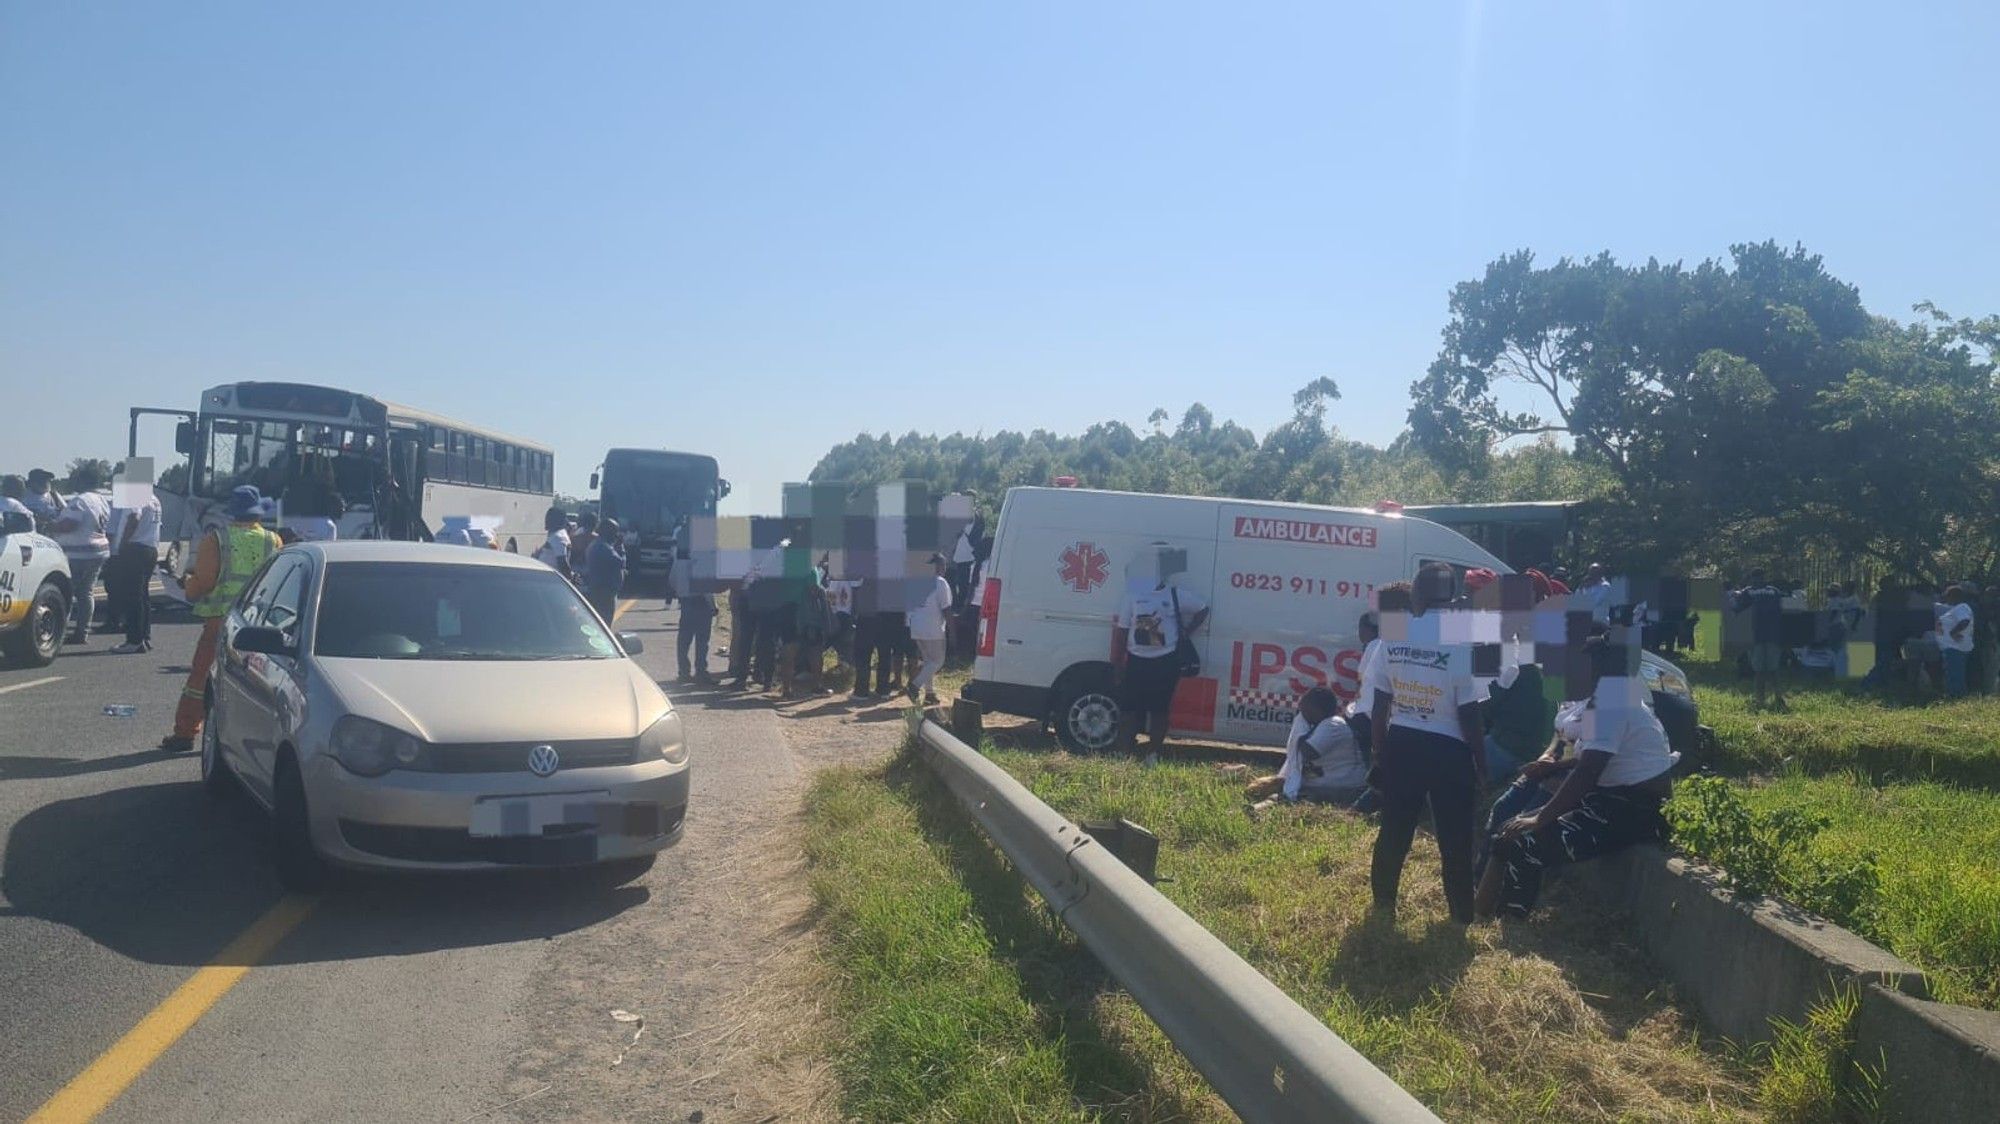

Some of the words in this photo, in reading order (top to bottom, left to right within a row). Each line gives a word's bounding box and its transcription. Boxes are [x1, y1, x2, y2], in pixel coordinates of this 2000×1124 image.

[1240, 518, 1372, 546] AMBULANCE
[1231, 572, 1282, 592] 0823
[1290, 576, 1326, 595] 911
[1231, 641, 1362, 699] IPSS
